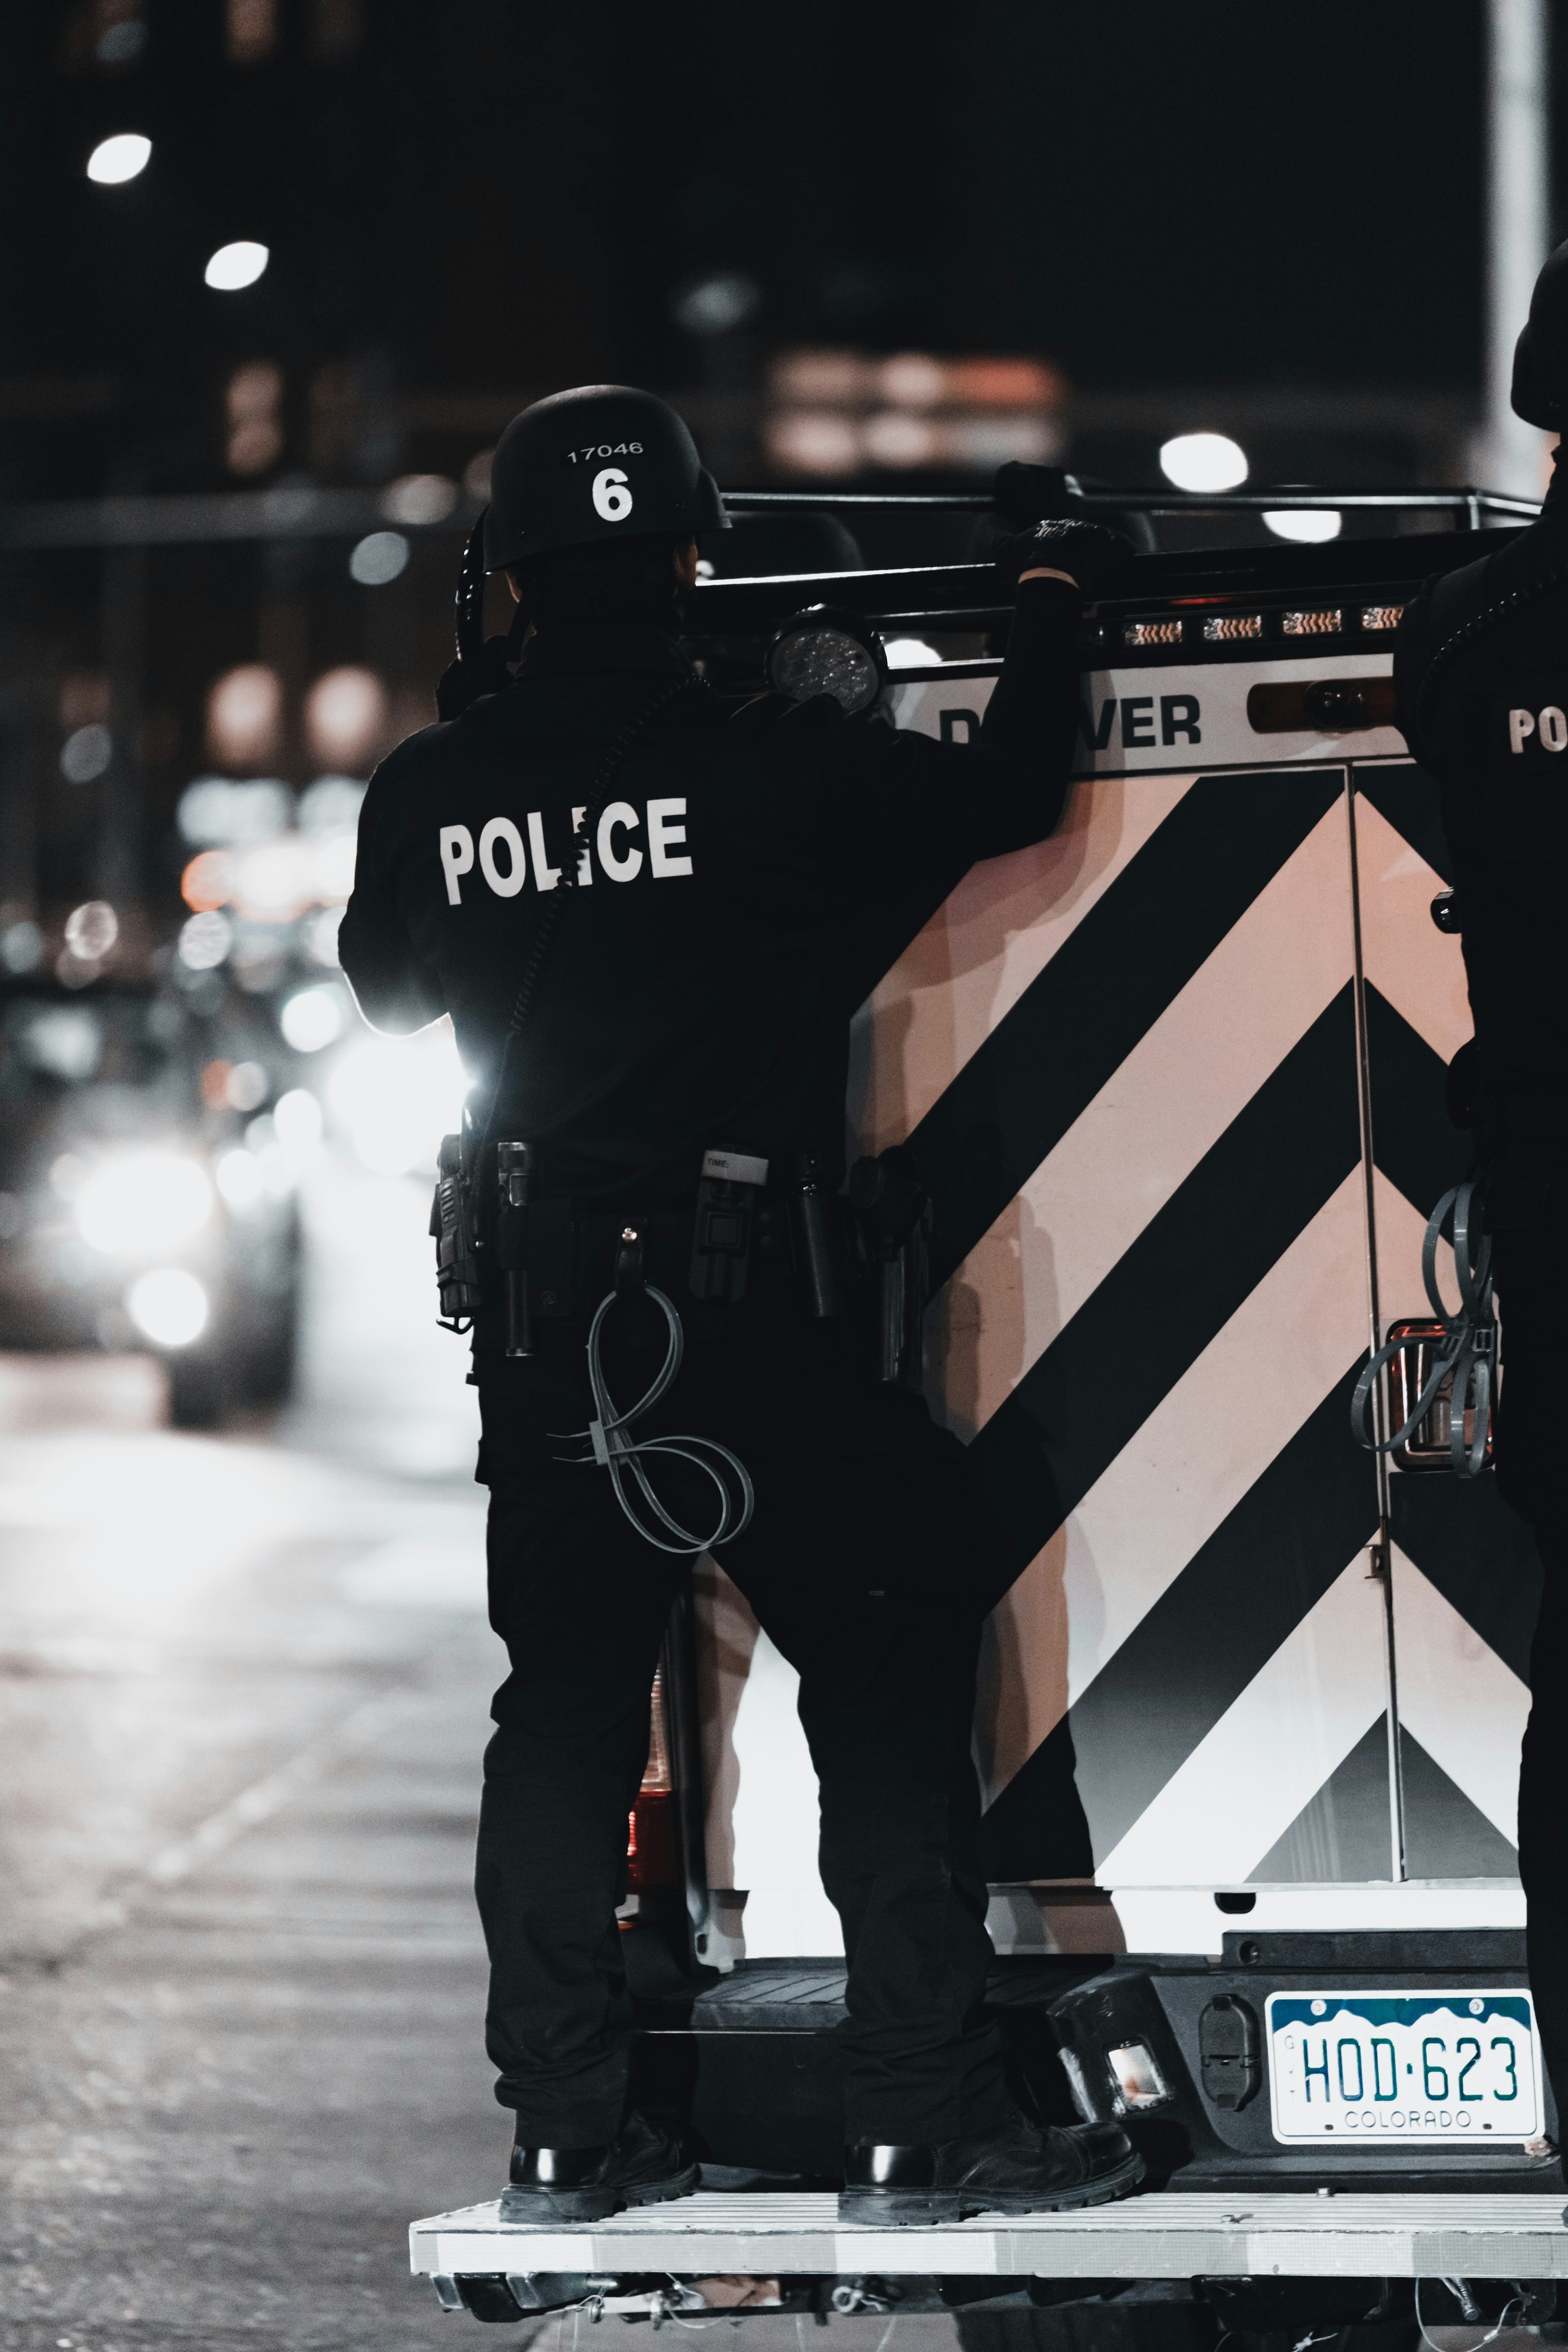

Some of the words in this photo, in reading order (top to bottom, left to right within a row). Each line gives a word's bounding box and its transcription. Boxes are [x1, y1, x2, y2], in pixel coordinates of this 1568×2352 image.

[567, 442, 644, 463] 17046
[592, 468, 632, 522] 6
[940, 695, 1201, 751] DVER
[1344, 2110, 1471, 2128] COLORADO
